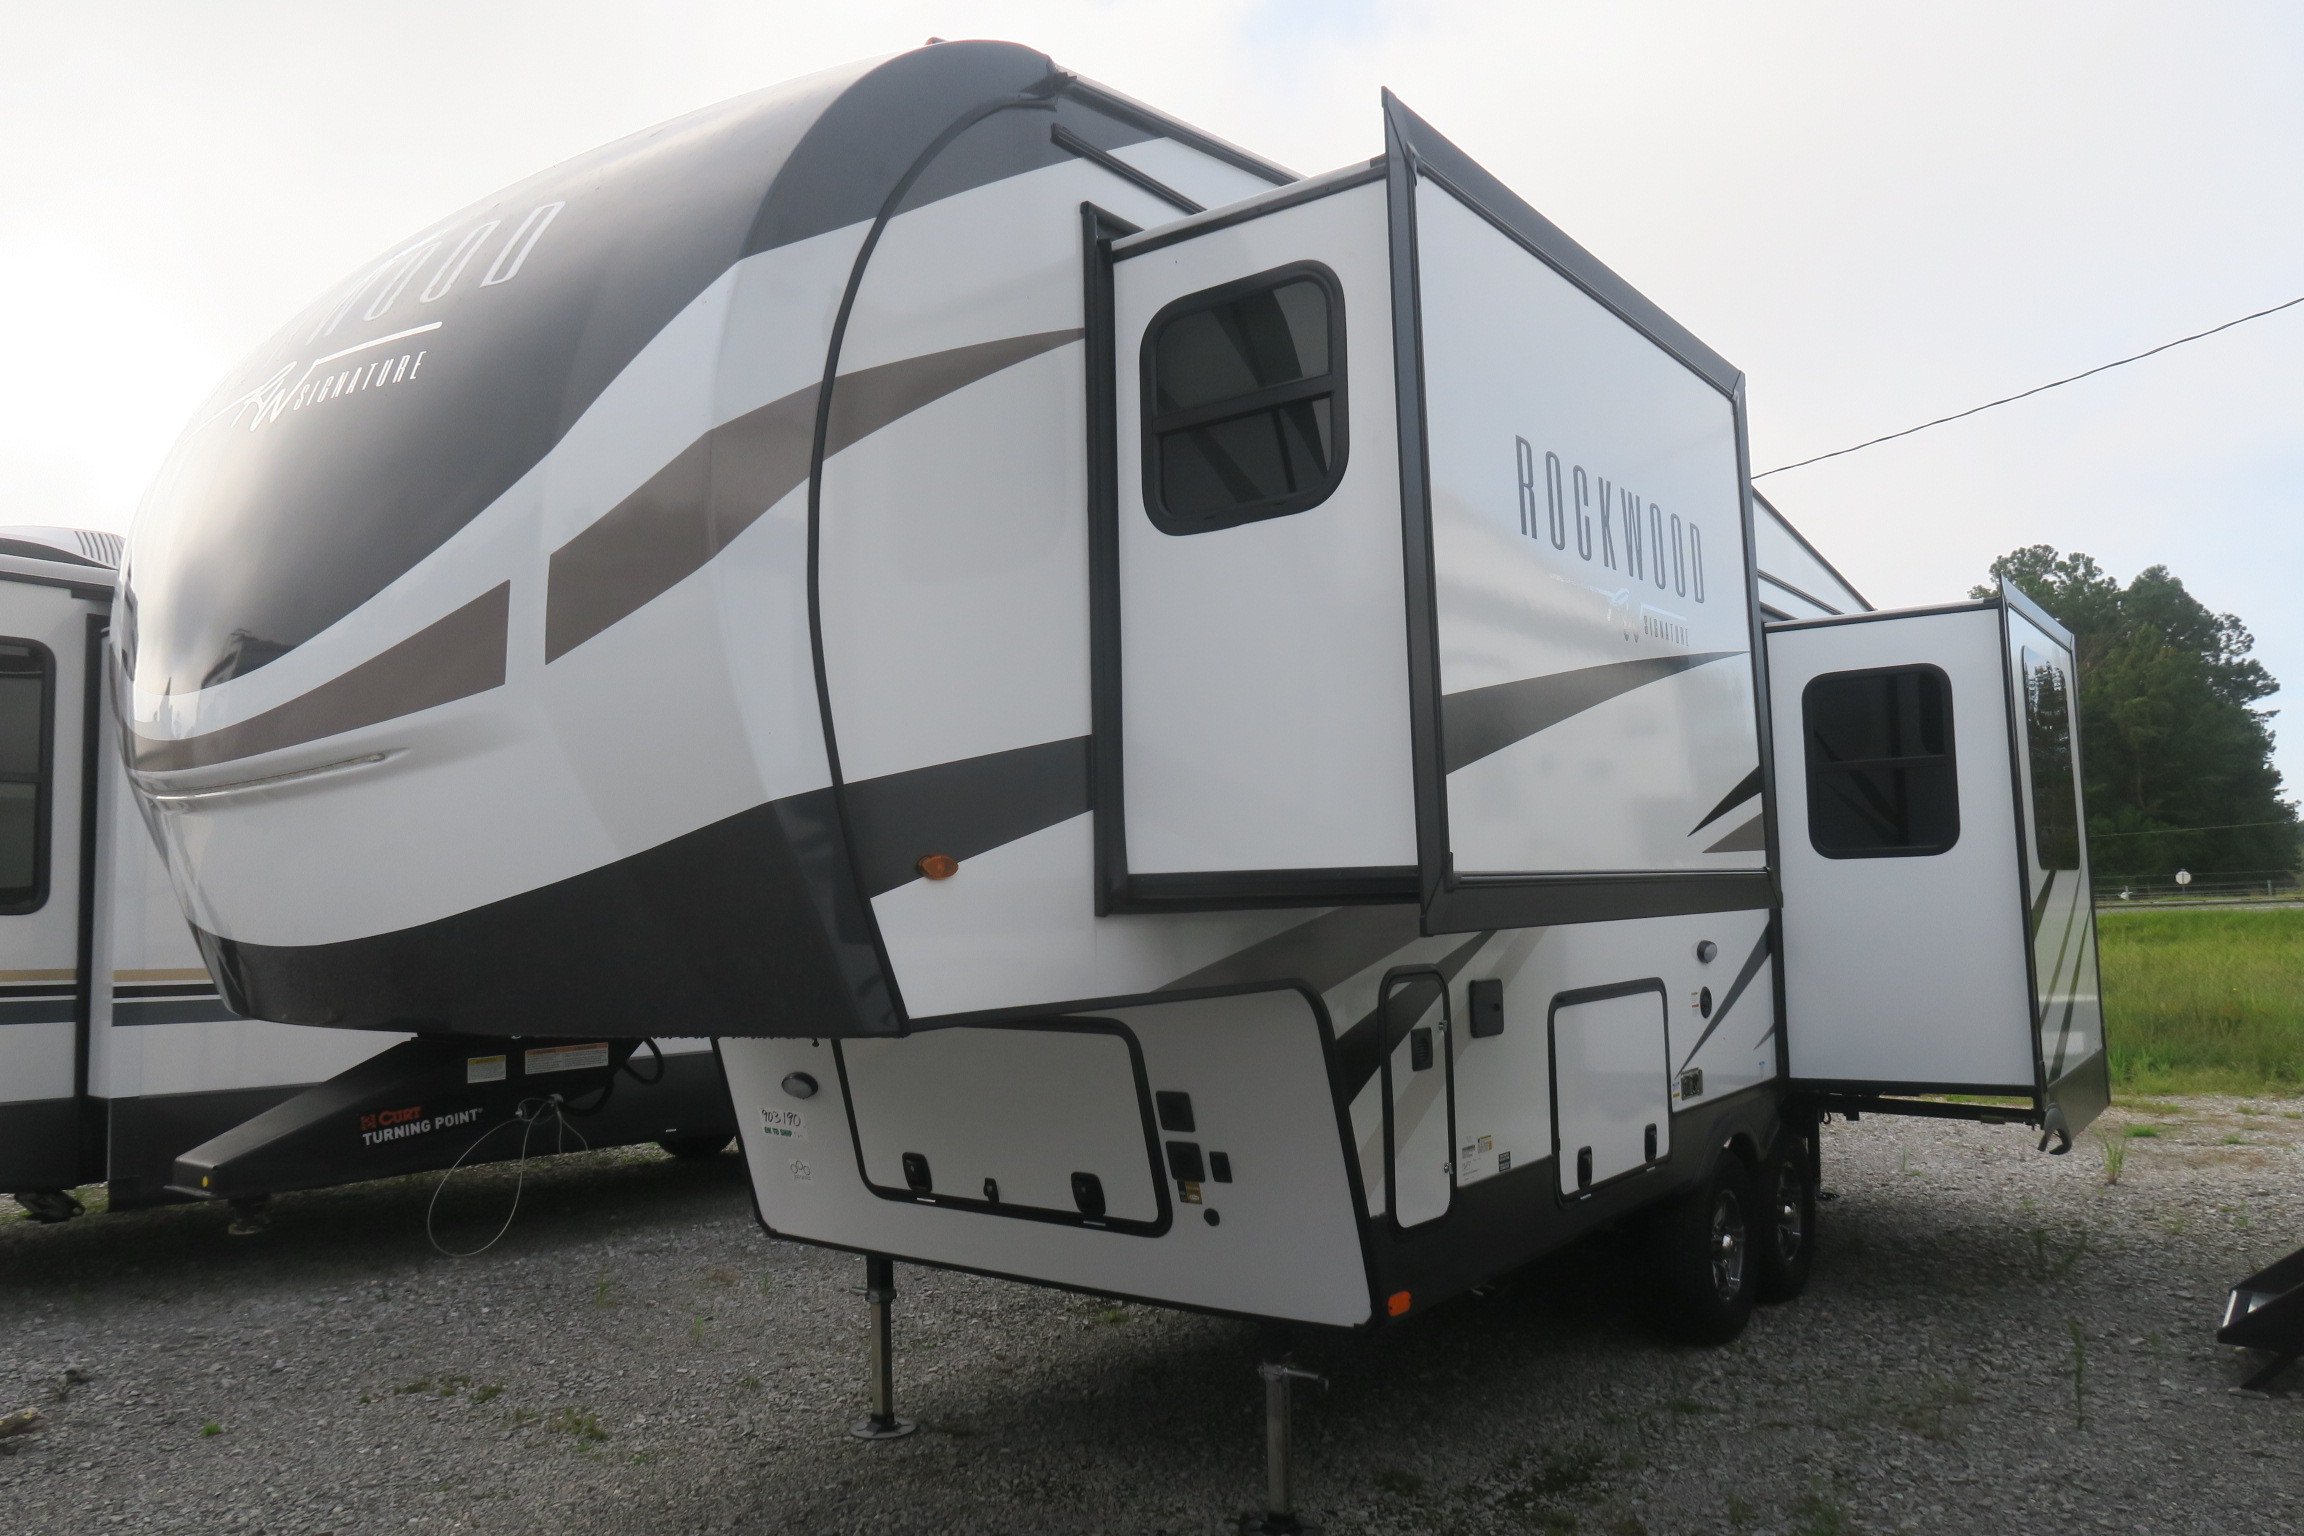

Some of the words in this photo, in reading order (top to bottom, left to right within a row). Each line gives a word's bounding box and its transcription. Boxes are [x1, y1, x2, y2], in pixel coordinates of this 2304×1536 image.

[293, 350, 427, 411] SIGNATURE
[1515, 434, 1705, 604] ROCKWOOD
[362, 1119, 432, 1147] TURNING
[378, 1105, 423, 1127] CURT
